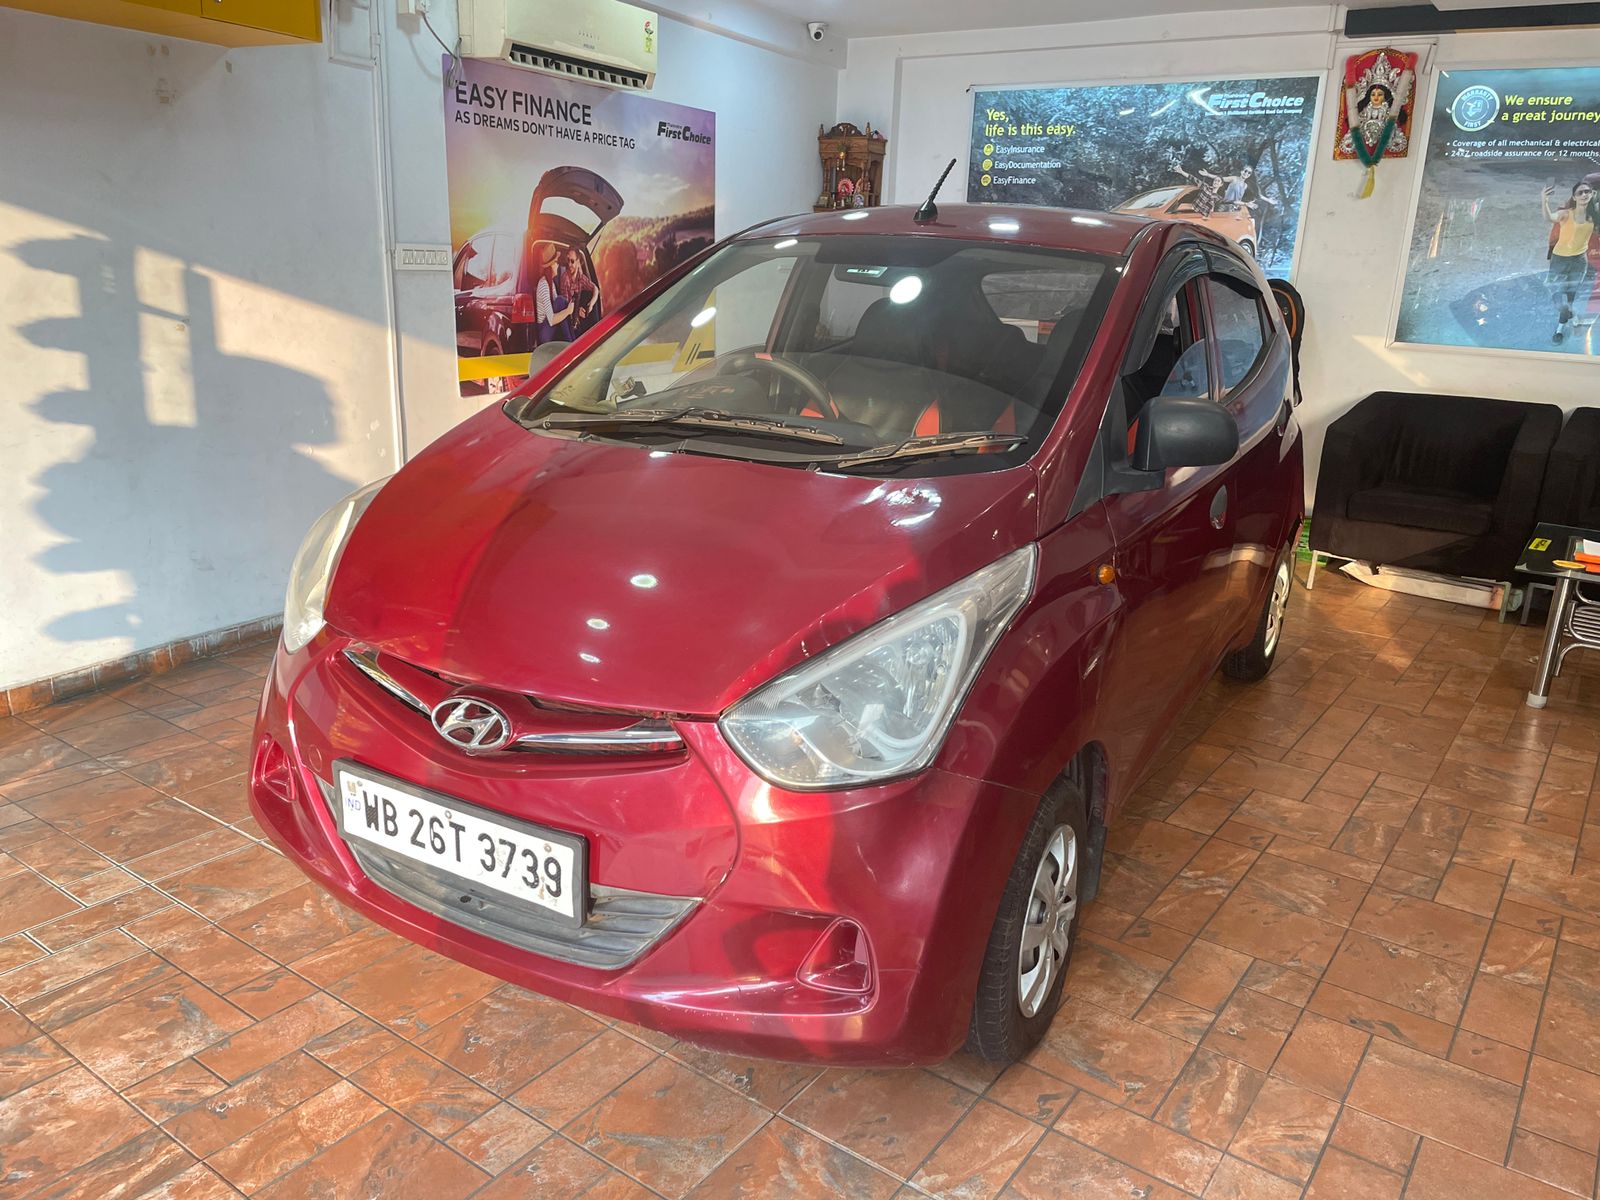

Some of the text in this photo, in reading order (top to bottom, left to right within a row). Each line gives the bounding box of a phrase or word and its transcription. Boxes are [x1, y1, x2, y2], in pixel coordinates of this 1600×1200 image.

[455, 80, 592, 126] EASY FINANCE
[1504, 95, 1573, 106] We ensure
[986, 108, 1009, 123] Yes,
[1501, 110, 1600, 123] a great journey
[1463, 120, 1482, 128] FIRST
[455, 110, 636, 150] AS DREAMS DON'T HAVE A PRICE TAG
[985, 123, 1076, 137] life is this easy.
[1452, 139, 1600, 148] Coverage of all mechanical & electrical
[995, 145, 1046, 155] EasyInsurance
[1504, 149, 1542, 157] assurance
[1543, 149, 1556, 157] for
[1558, 149, 1569, 157] 12
[994, 161, 1062, 171] EasyDocumentation
[993, 176, 1037, 186] EasyFinance
[362, 790, 562, 898] WB 26T 3739
